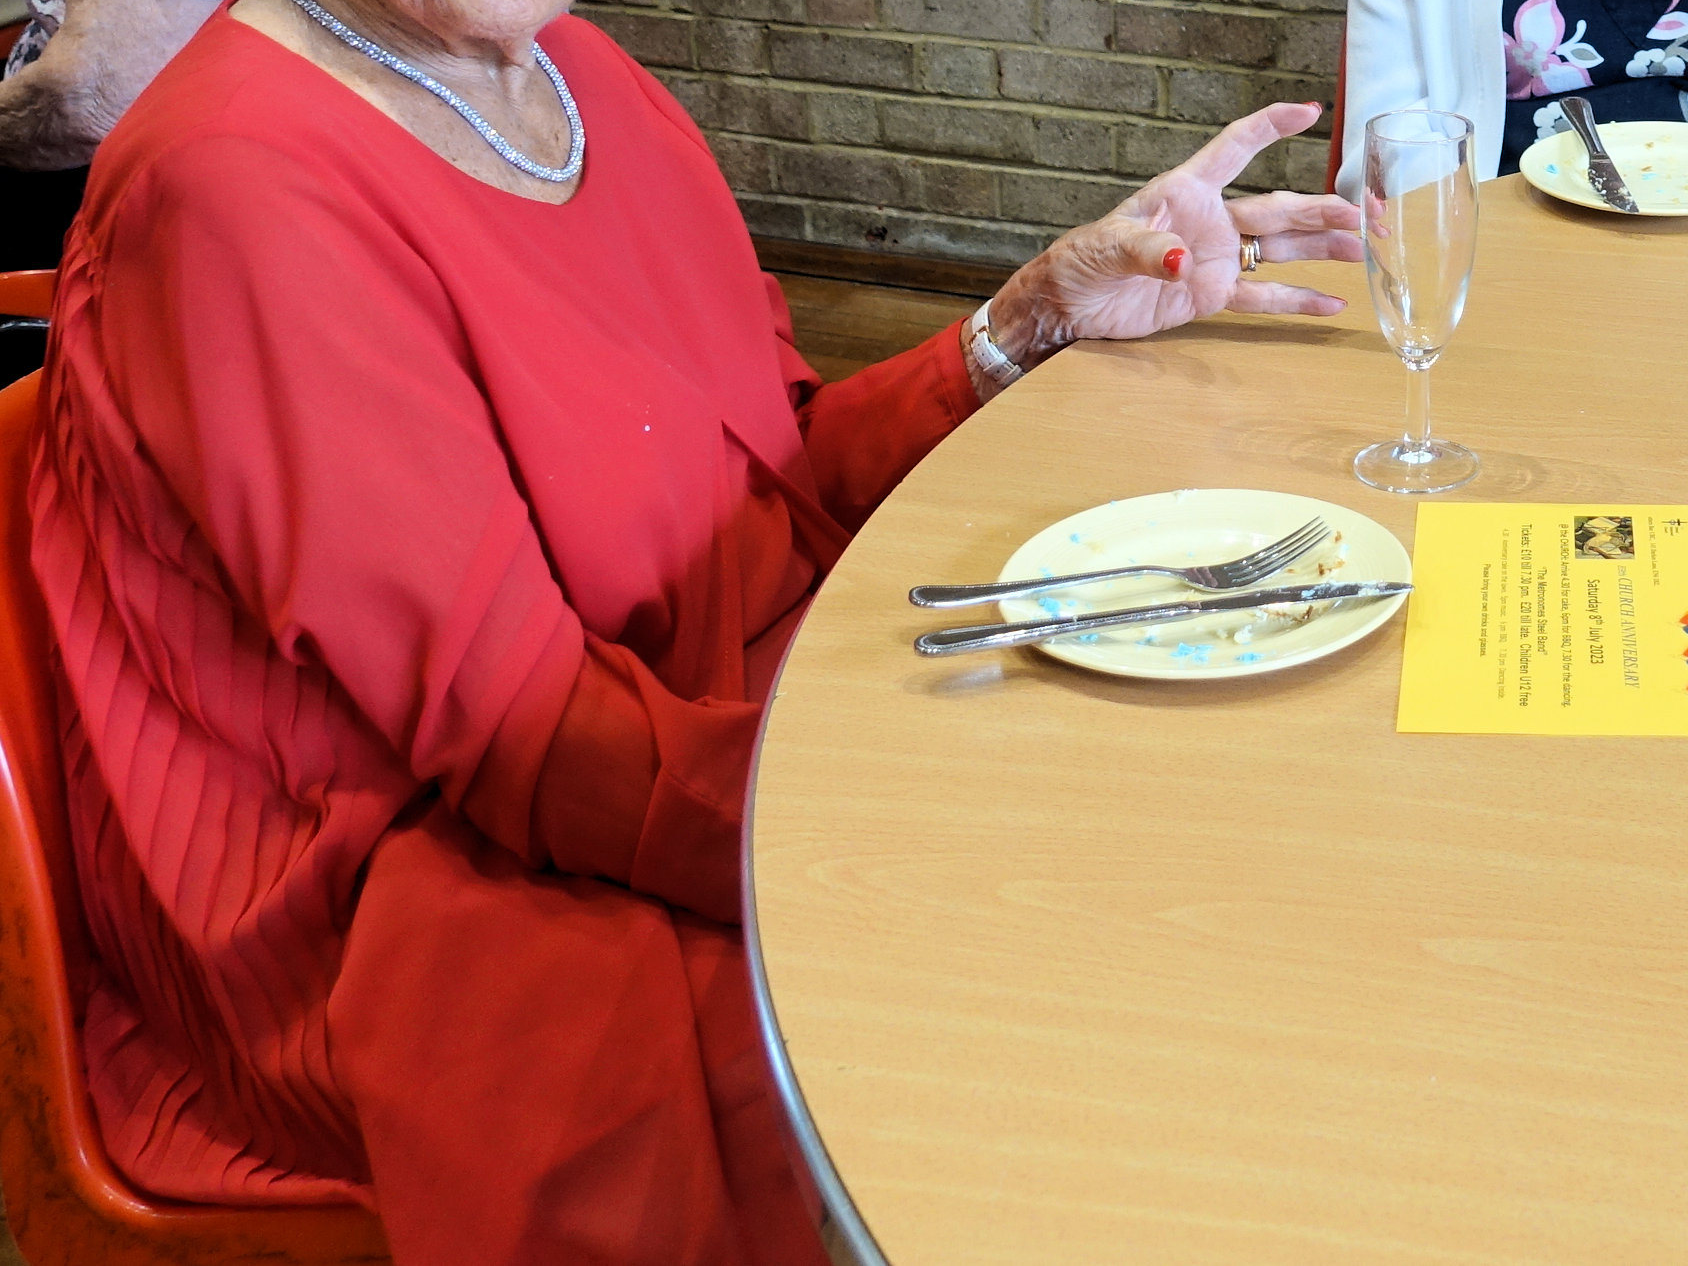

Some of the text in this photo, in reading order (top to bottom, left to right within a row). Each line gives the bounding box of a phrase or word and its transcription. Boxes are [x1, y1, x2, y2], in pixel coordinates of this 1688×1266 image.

[1521, 524, 1532, 548] Tickets:
[1521, 549, 1532, 560] £10
[1482, 564, 1491, 578] Please
[1521, 562, 1532, 570] till
[1561, 562, 1570, 576] Arrive
[1481, 579, 1490, 590] bring
[1520, 572, 1532, 584] 7.30
[1561, 578, 1570, 588] 4.30
[1537, 582, 1547, 618] Metronomes
[1618, 577, 1635, 617] CHURCH
[1520, 602, 1532, 613] £20
[1561, 598, 1571, 611] cake,
[1520, 615, 1532, 623] till
[1560, 613, 1571, 624] 6pm
[1586, 579, 1605, 664] Saturday 8th July 2023
[1520, 625, 1532, 639] late.
[1537, 619, 1548, 634] Steel
[1520, 644, 1532, 674] Children
[1562, 650, 1572, 661] 7.30
[1620, 618, 1640, 689] ANNIVERSARY
[1563, 663, 1573, 671] for
[1520, 676, 1531, 690] U12
[1563, 672, 1573, 682] the
[1520, 692, 1532, 706] free
